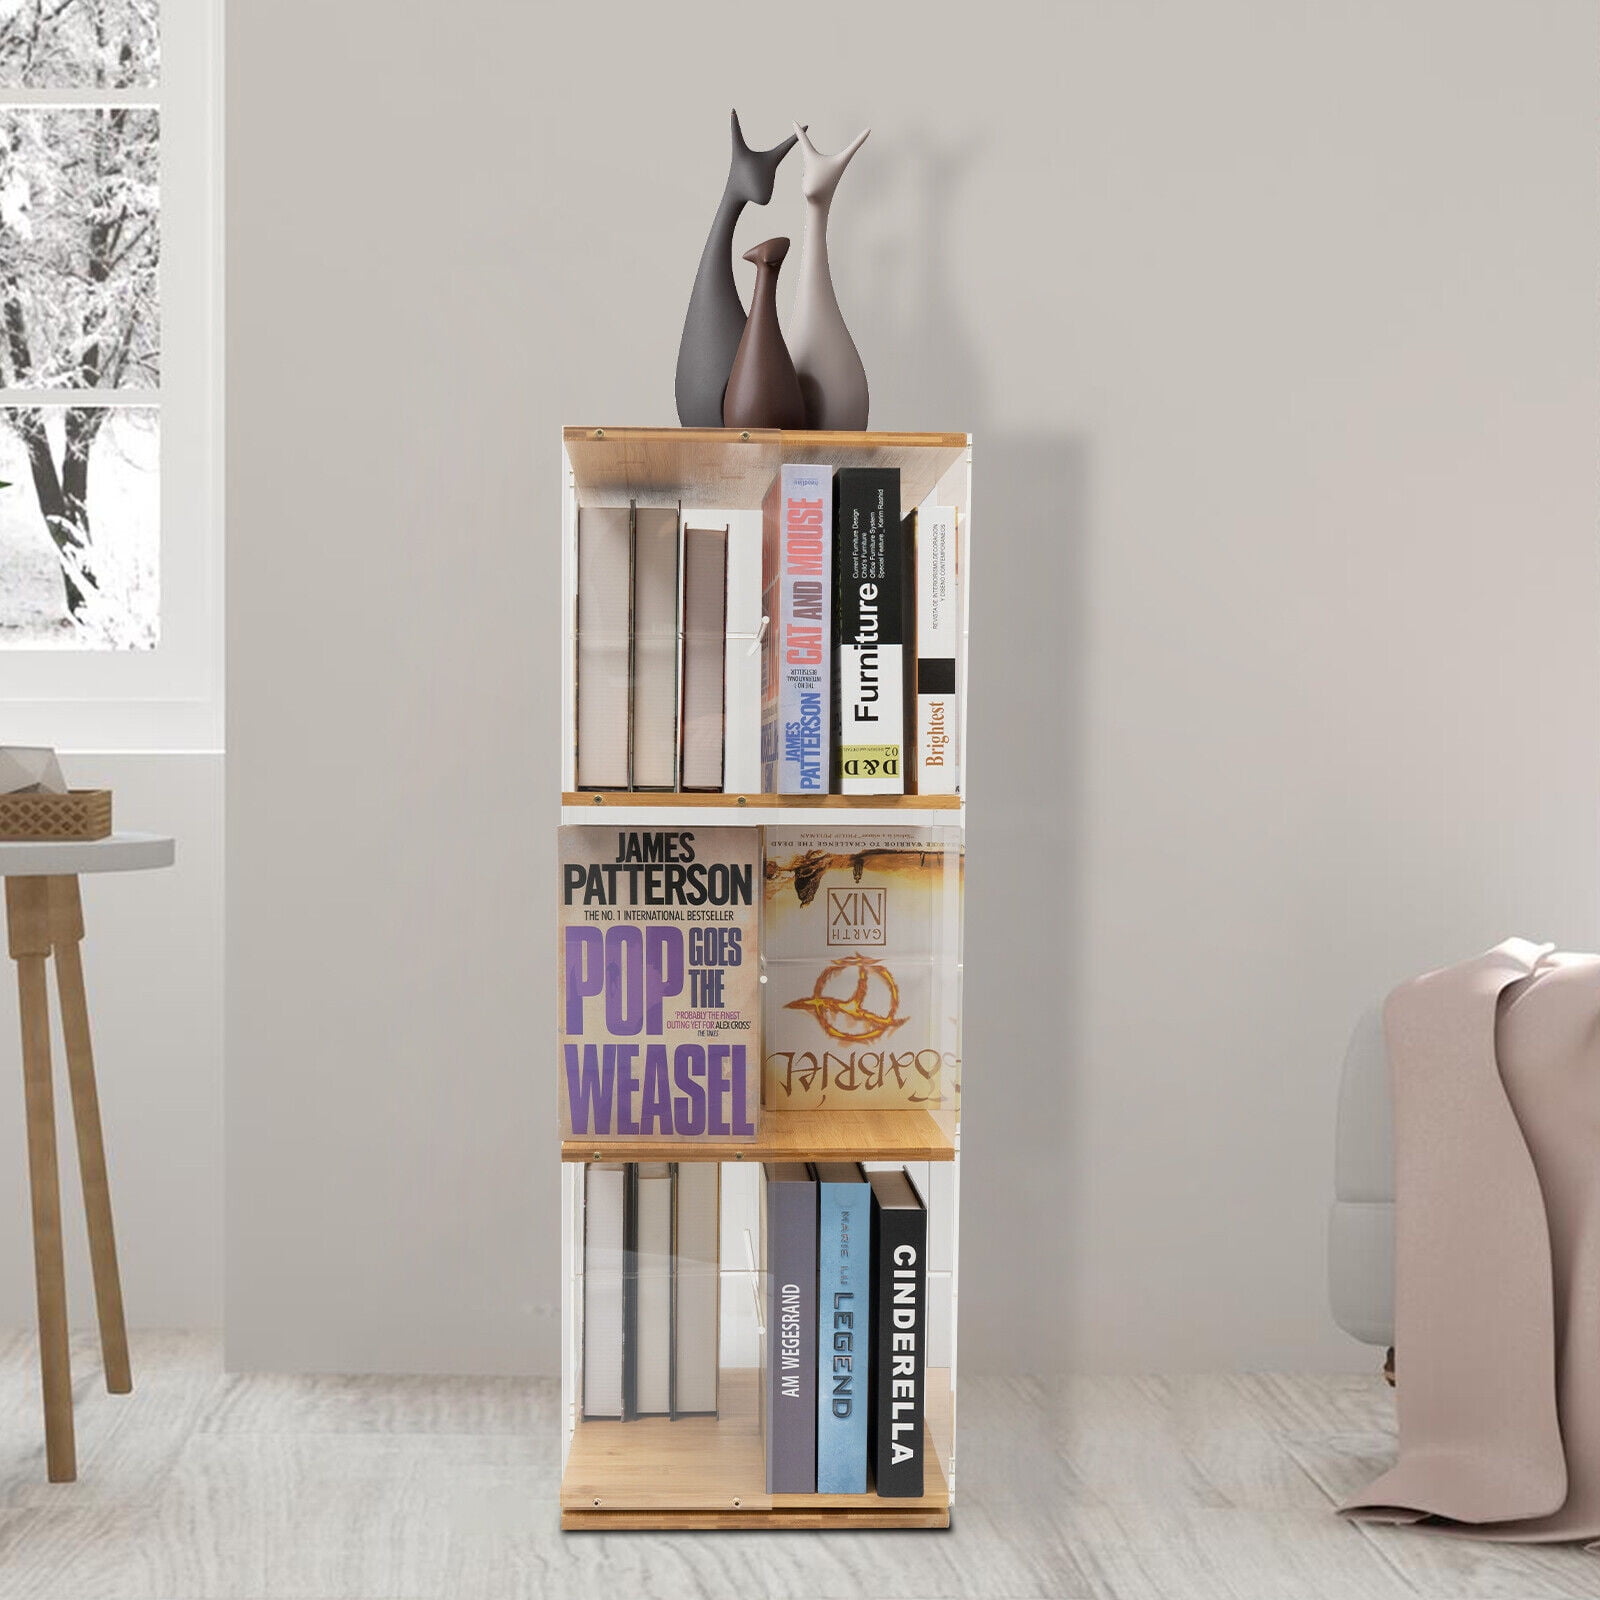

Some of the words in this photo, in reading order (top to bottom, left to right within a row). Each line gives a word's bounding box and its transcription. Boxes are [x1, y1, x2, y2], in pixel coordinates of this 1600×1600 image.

[787, 498, 823, 576] MOUSE
[852, 508, 860, 529] Design
[793, 581, 822, 620] AND
[932, 599, 938, 607] DE
[786, 624, 823, 665] CAT
[854, 583, 879, 722] Furniture
[785, 721, 800, 762] JAMES
[800, 692, 821, 789] PATTERSON
[885, 747, 898, 757] 02
[925, 701, 949, 767] Brightest
[615, 832, 695, 864] JAMES
[564, 863, 752, 906] PATTERSON
[584, 910, 599, 921] THE
[601, 910, 615, 921] NO.
[617, 910, 621, 921] 1
[623, 910, 685, 921] INTERNATIONAL
[687, 910, 734, 921] BESTSELLER
[831, 892, 882, 926] NIX
[688, 927, 742, 967] GOES
[832, 928, 882, 940] GARTH
[565, 925, 684, 1036] POP
[688, 969, 725, 1008] THE
[666, 1020, 690, 1029] OUTING
[691, 1020, 702, 1029] YET
[703, 1020, 715, 1029] FOR
[715, 1020, 730, 1030] ALEX
[708, 1011, 720, 1020] THE
[720, 1011, 741, 1020] FINEST
[564, 1043, 754, 1136] WEASEL
[840, 1211, 849, 1257] MARIE
[782, 1283, 800, 1369] WEGESRAND
[832, 1292, 854, 1418] LEGEND
[891, 1244, 917, 1465] CINDERELLA
[782, 1375, 800, 1398] AM
